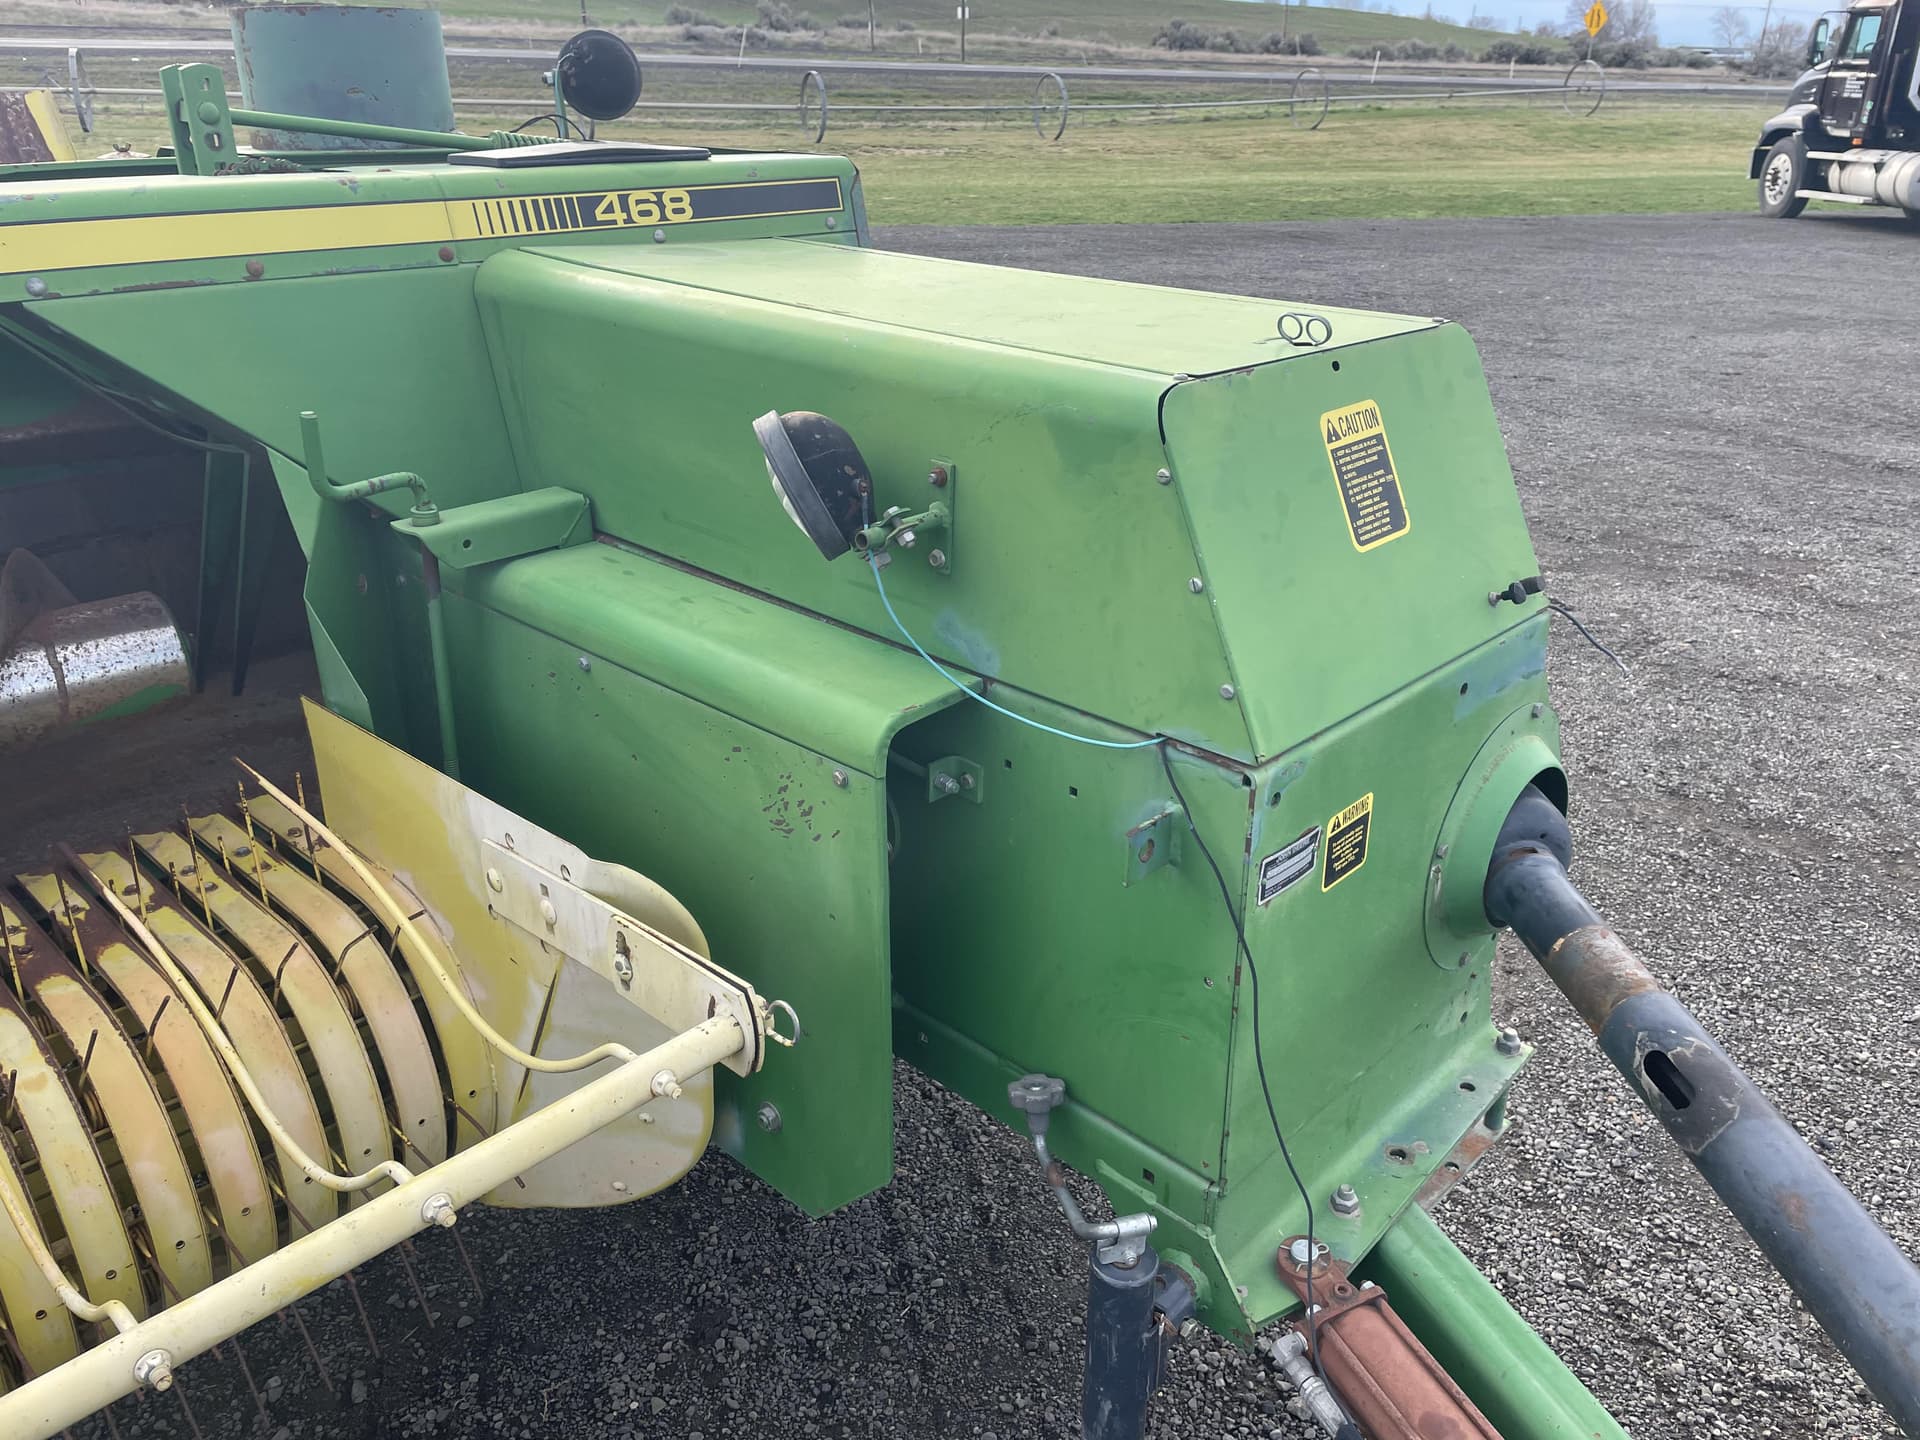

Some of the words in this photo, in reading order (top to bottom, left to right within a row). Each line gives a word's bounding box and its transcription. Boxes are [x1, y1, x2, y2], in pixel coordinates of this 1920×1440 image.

[594, 190, 694, 225] 468
[1338, 406, 1380, 438] CAUTION
[1342, 796, 1369, 825] WARNING
